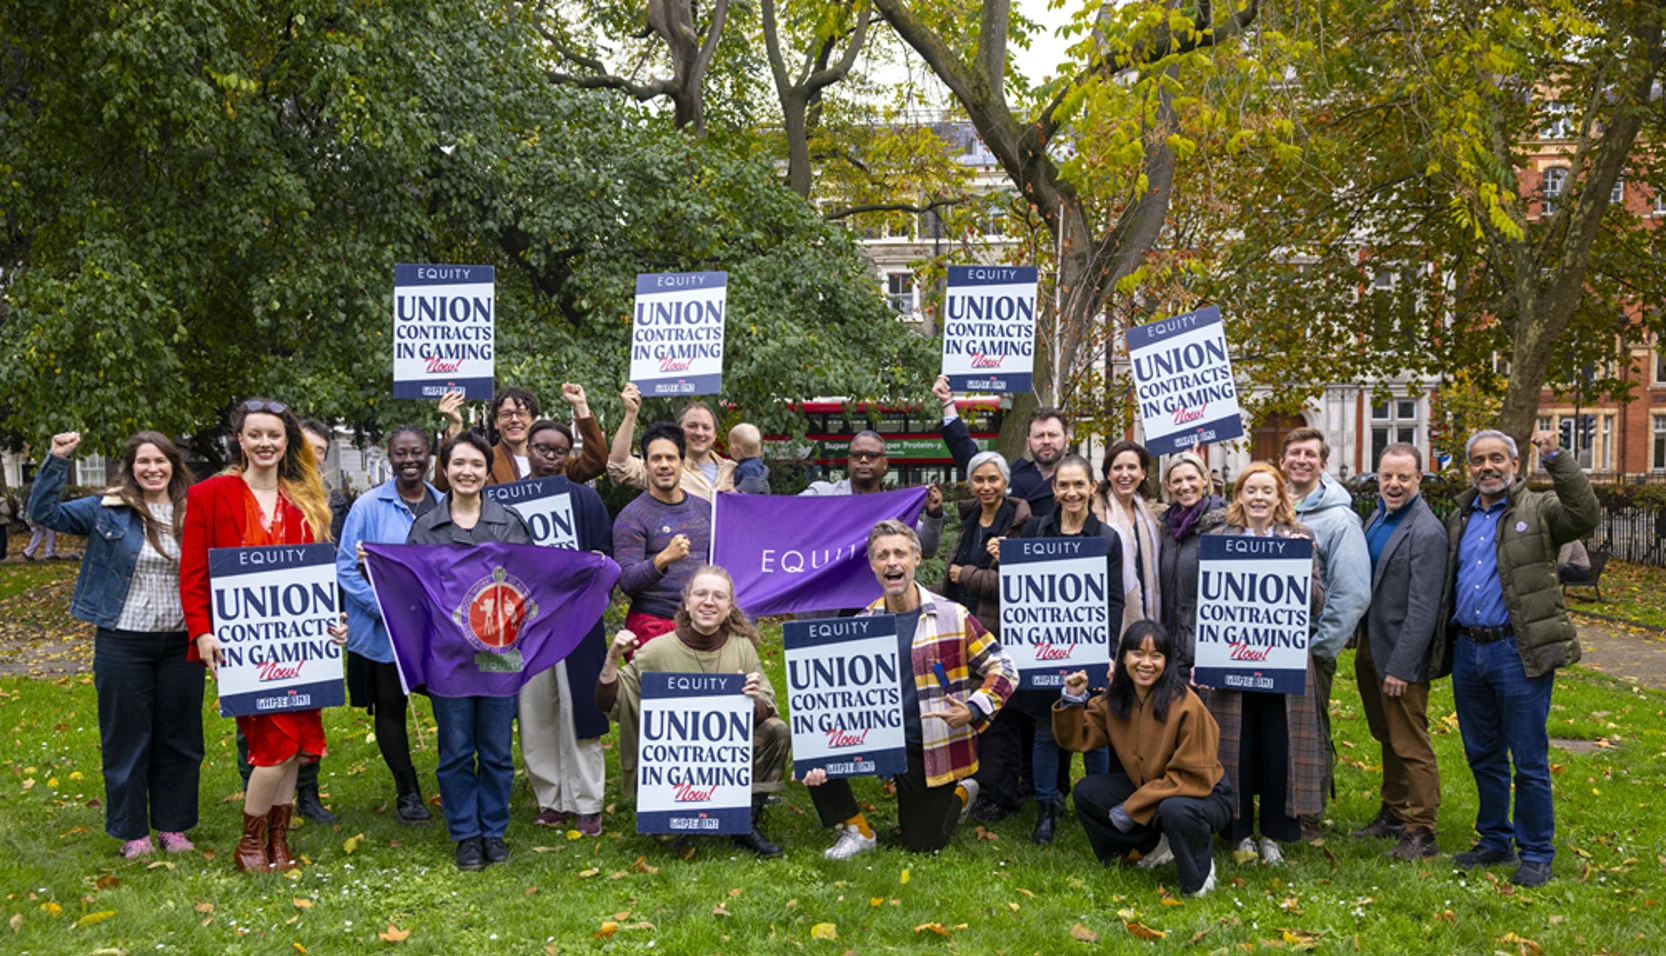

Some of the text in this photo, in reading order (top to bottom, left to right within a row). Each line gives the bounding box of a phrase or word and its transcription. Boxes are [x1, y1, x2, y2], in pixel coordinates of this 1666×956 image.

[418, 268, 471, 279] EQUITY
[658, 276, 705, 286] EQUITY
[968, 270, 1016, 279] EQUITY
[397, 296, 491, 322] UNION
[637, 300, 722, 325] UNION
[949, 296, 1034, 320] UNION
[396, 325, 492, 340] CONTRACTS
[635, 327, 722, 342] CONTRACTS
[947, 323, 1032, 337] CONTRACTS
[1147, 315, 1197, 337] EQUITY
[397, 343, 491, 360] IN GAMING
[634, 343, 720, 360] IN GAMING
[946, 340, 1032, 356] IN GAMING
[425, 356, 464, 372] Now!
[659, 356, 694, 371] Now!
[970, 352, 1006, 367] Now!
[1134, 337, 1226, 382] UNION
[1140, 365, 1230, 399] CONTRACTS
[1142, 382, 1234, 419] IN GAMING
[1171, 402, 1207, 423] Now!
[824, 442, 849, 450] Super
[488, 482, 543, 501] EQUITY
[1024, 542, 1081, 554] EQUITY
[1226, 540, 1286, 554] EQUITY
[240, 549, 306, 565] EQUITY
[1003, 573, 1104, 604] UNION
[1202, 571, 1308, 605] UNION
[215, 582, 335, 620] UNION
[1003, 606, 1106, 624] CONTRACTS
[1200, 604, 1307, 626] CONTRACTS
[809, 622, 869, 637] EQUITY
[1004, 626, 1106, 645] IN GAMING
[1199, 624, 1306, 649] IN GAMING
[248, 640, 340, 665] GAMING
[1034, 642, 1076, 659] Now!
[1229, 642, 1273, 660] Now!
[256, 659, 305, 681] Now!
[789, 653, 896, 690] UNION
[668, 677, 728, 690] EQUITY
[792, 688, 899, 711] CONTRACTS
[644, 710, 750, 742] UNION
[793, 709, 901, 734] IN GAMING
[825, 727, 869, 747] Now!
[642, 745, 750, 763] CONTRACTS
[642, 767, 749, 786] IN GAMING
[673, 782, 717, 801] Now!
